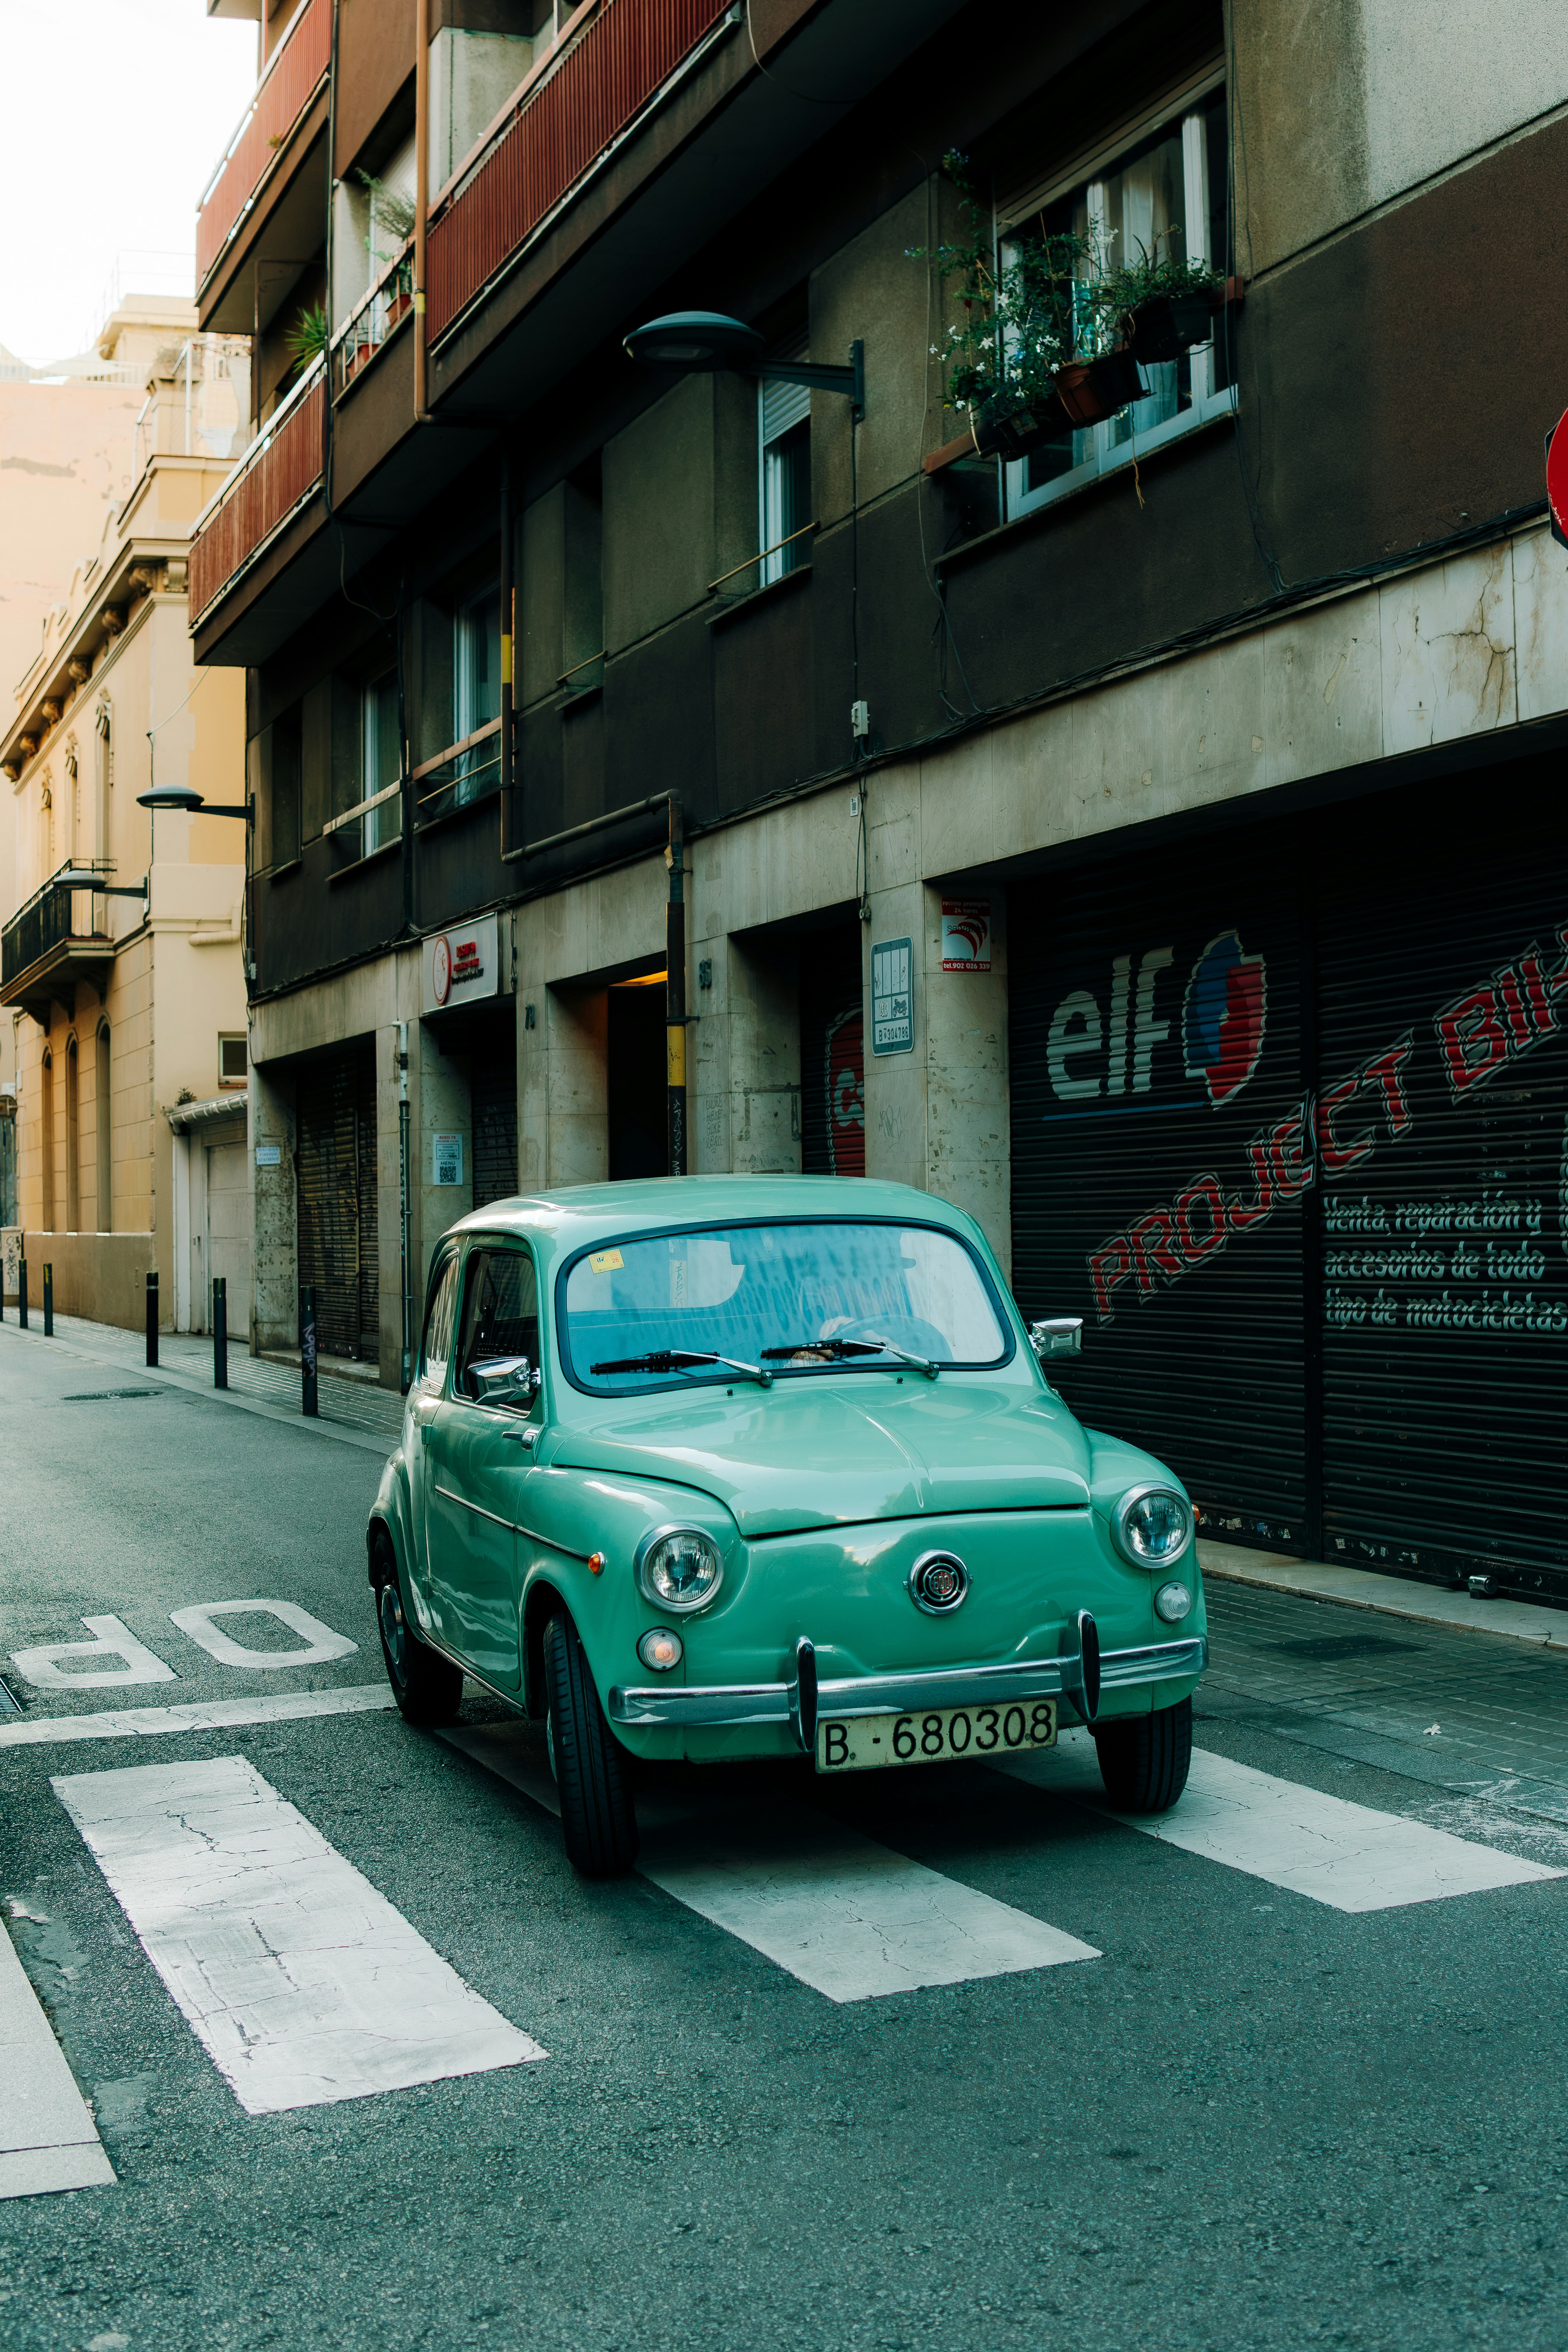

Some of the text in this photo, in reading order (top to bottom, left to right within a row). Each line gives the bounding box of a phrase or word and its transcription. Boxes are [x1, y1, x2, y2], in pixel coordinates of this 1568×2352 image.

[1087, 1028, 1414, 1328] PROJECT
[1324, 1191, 1542, 1237] Venta, reparación y
[1325, 1241, 1545, 1279] accesorios de todo
[1325, 1288, 1568, 1332] tipo de motocicletas
[933, 1575, 949, 1590] 600
